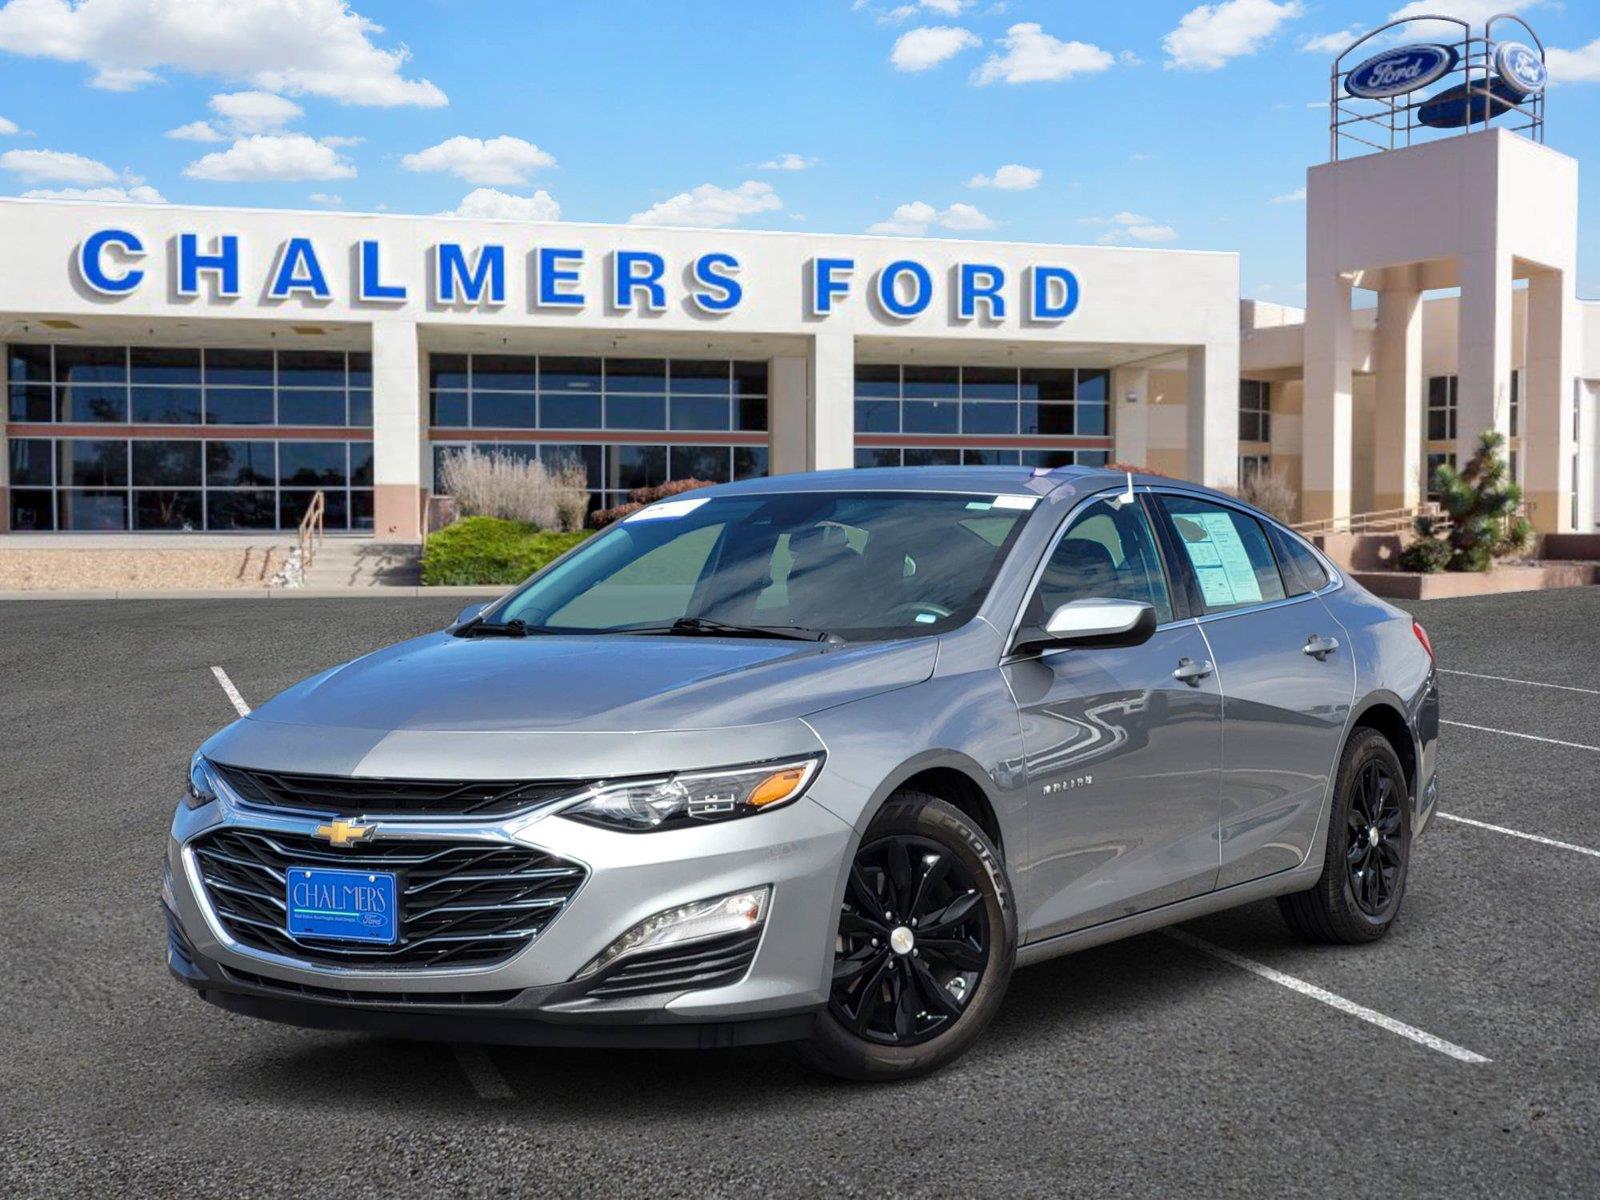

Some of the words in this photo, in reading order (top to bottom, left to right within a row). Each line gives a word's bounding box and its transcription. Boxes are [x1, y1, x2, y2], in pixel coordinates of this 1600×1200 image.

[1367, 56, 1423, 87] Ford
[82, 229, 741, 311] CHALMERS
[816, 258, 1079, 319] FORD
[293, 882, 386, 912] CHALMERS
[363, 914, 382, 926] Ford
